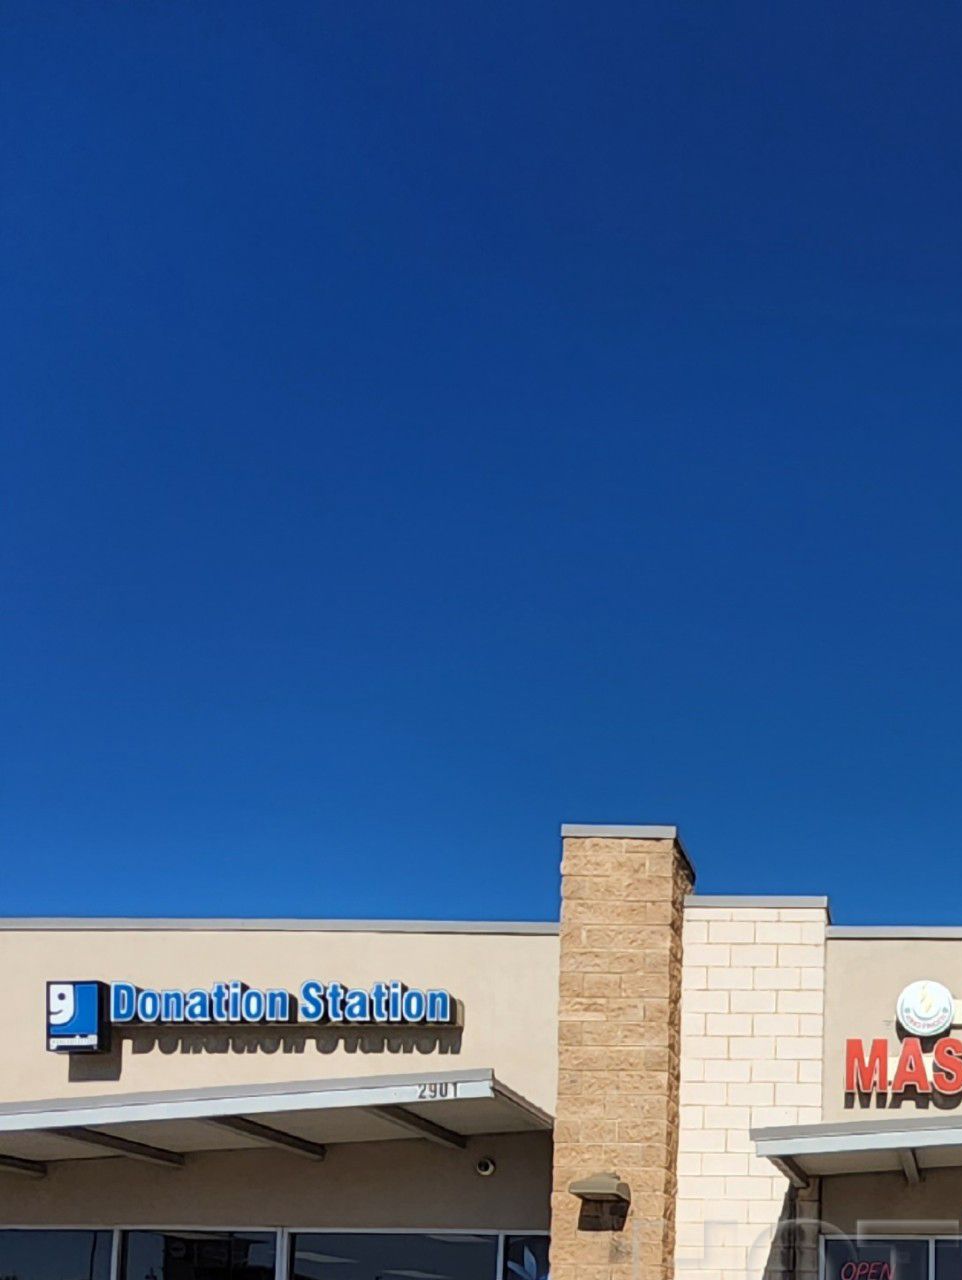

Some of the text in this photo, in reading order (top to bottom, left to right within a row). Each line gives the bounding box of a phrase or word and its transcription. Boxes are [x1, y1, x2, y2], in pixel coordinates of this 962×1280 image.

[110, 979, 451, 1022] Donation Station
[418, 1082, 458, 1099] 2901
